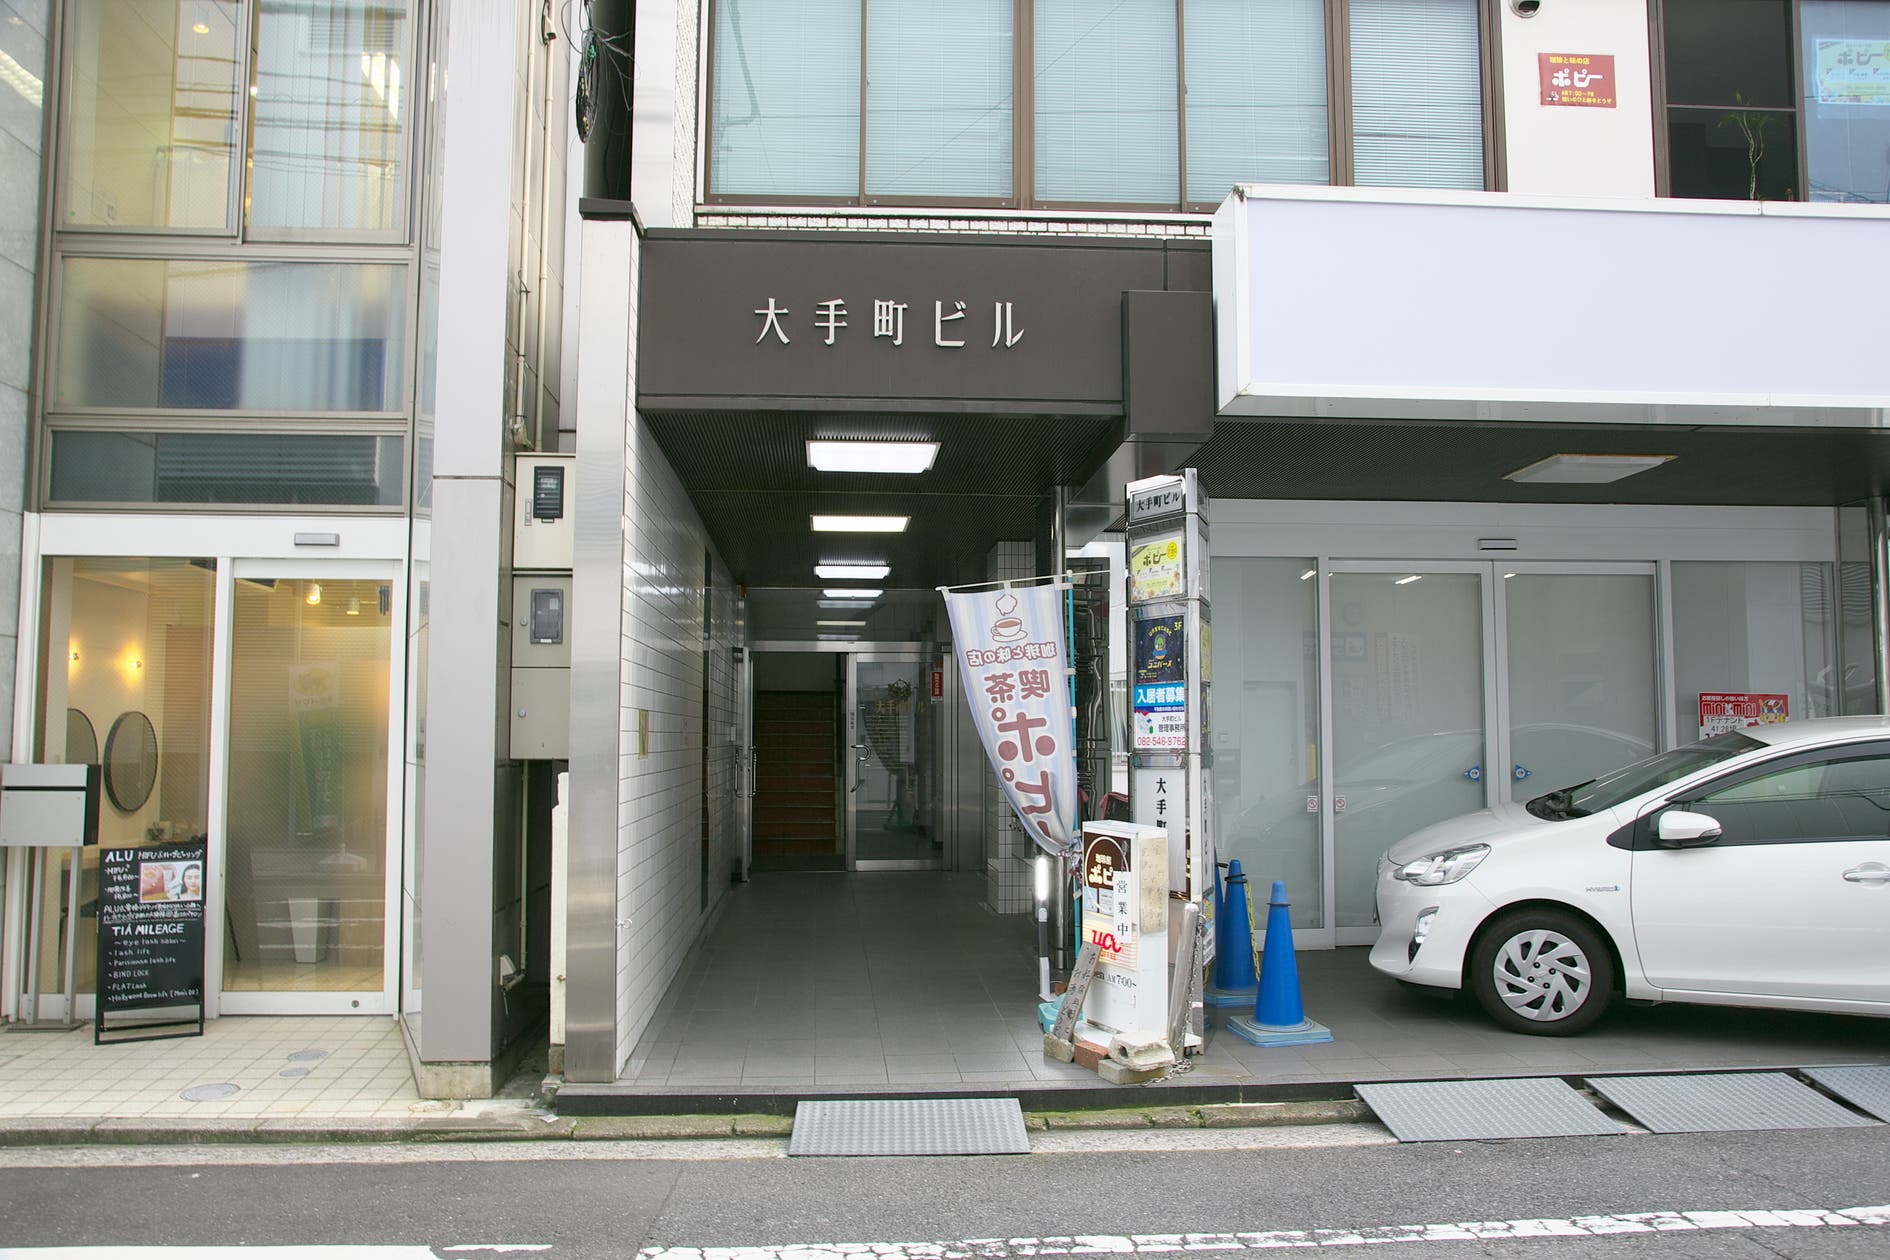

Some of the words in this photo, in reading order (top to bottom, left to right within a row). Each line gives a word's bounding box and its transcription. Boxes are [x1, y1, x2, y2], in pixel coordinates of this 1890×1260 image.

[1551, 68, 1603, 88] ポピー
[755, 298, 1025, 348] 大手町ビル
[1136, 492, 1180, 512] 大手町ビル
[1143, 550, 1167, 566] ポピー
[1174, 621, 1183, 631] 3F
[1137, 686, 1184, 704] 入居者募集
[1156, 777, 1167, 828] 大手町
[105, 850, 134, 863] ALU
[1088, 864, 1114, 887] ポピ
[1117, 880, 1129, 937] 営業中
[135, 923, 184, 936] MILEAGE
[113, 970, 132, 978] BIND
[133, 969, 150, 977] LOCK
